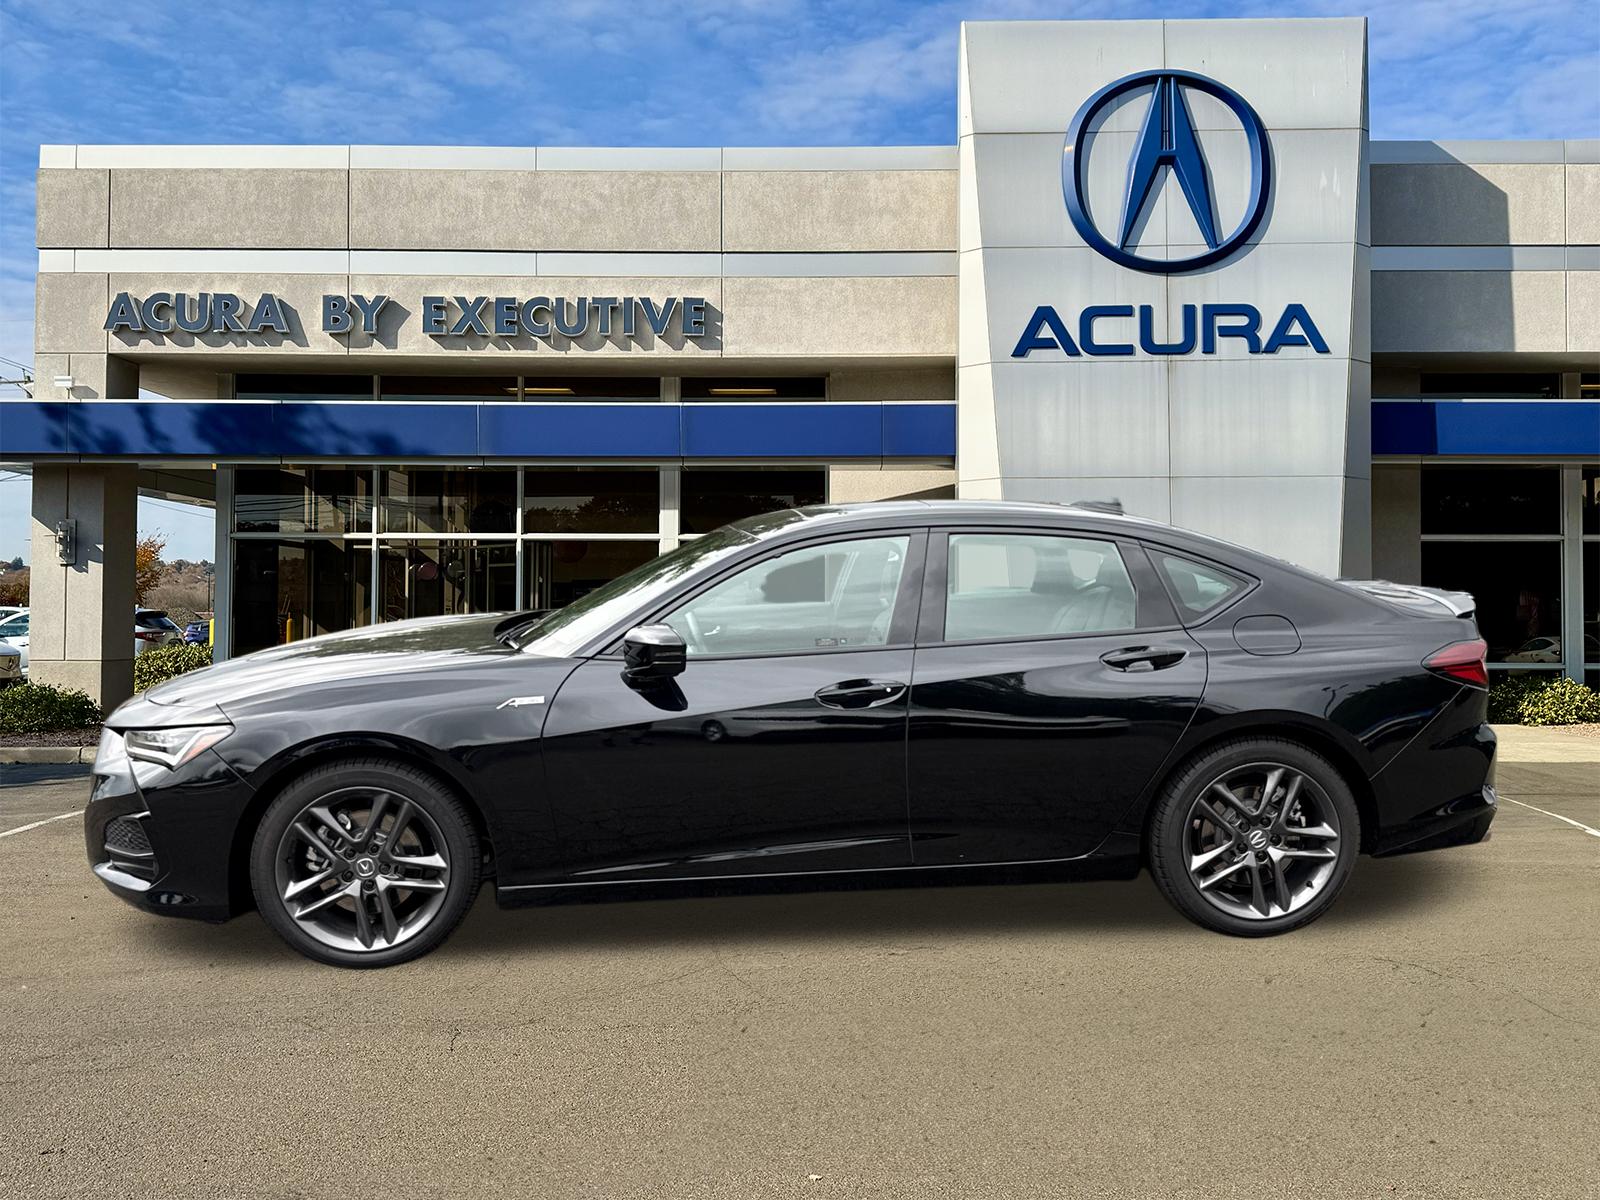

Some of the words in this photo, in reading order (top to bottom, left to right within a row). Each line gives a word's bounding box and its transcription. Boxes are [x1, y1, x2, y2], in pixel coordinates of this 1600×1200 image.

[103, 292, 291, 333] ACURA
[322, 294, 391, 334] BY
[422, 296, 705, 337] EXECUTIVE
[1011, 303, 1332, 357] ACURA
